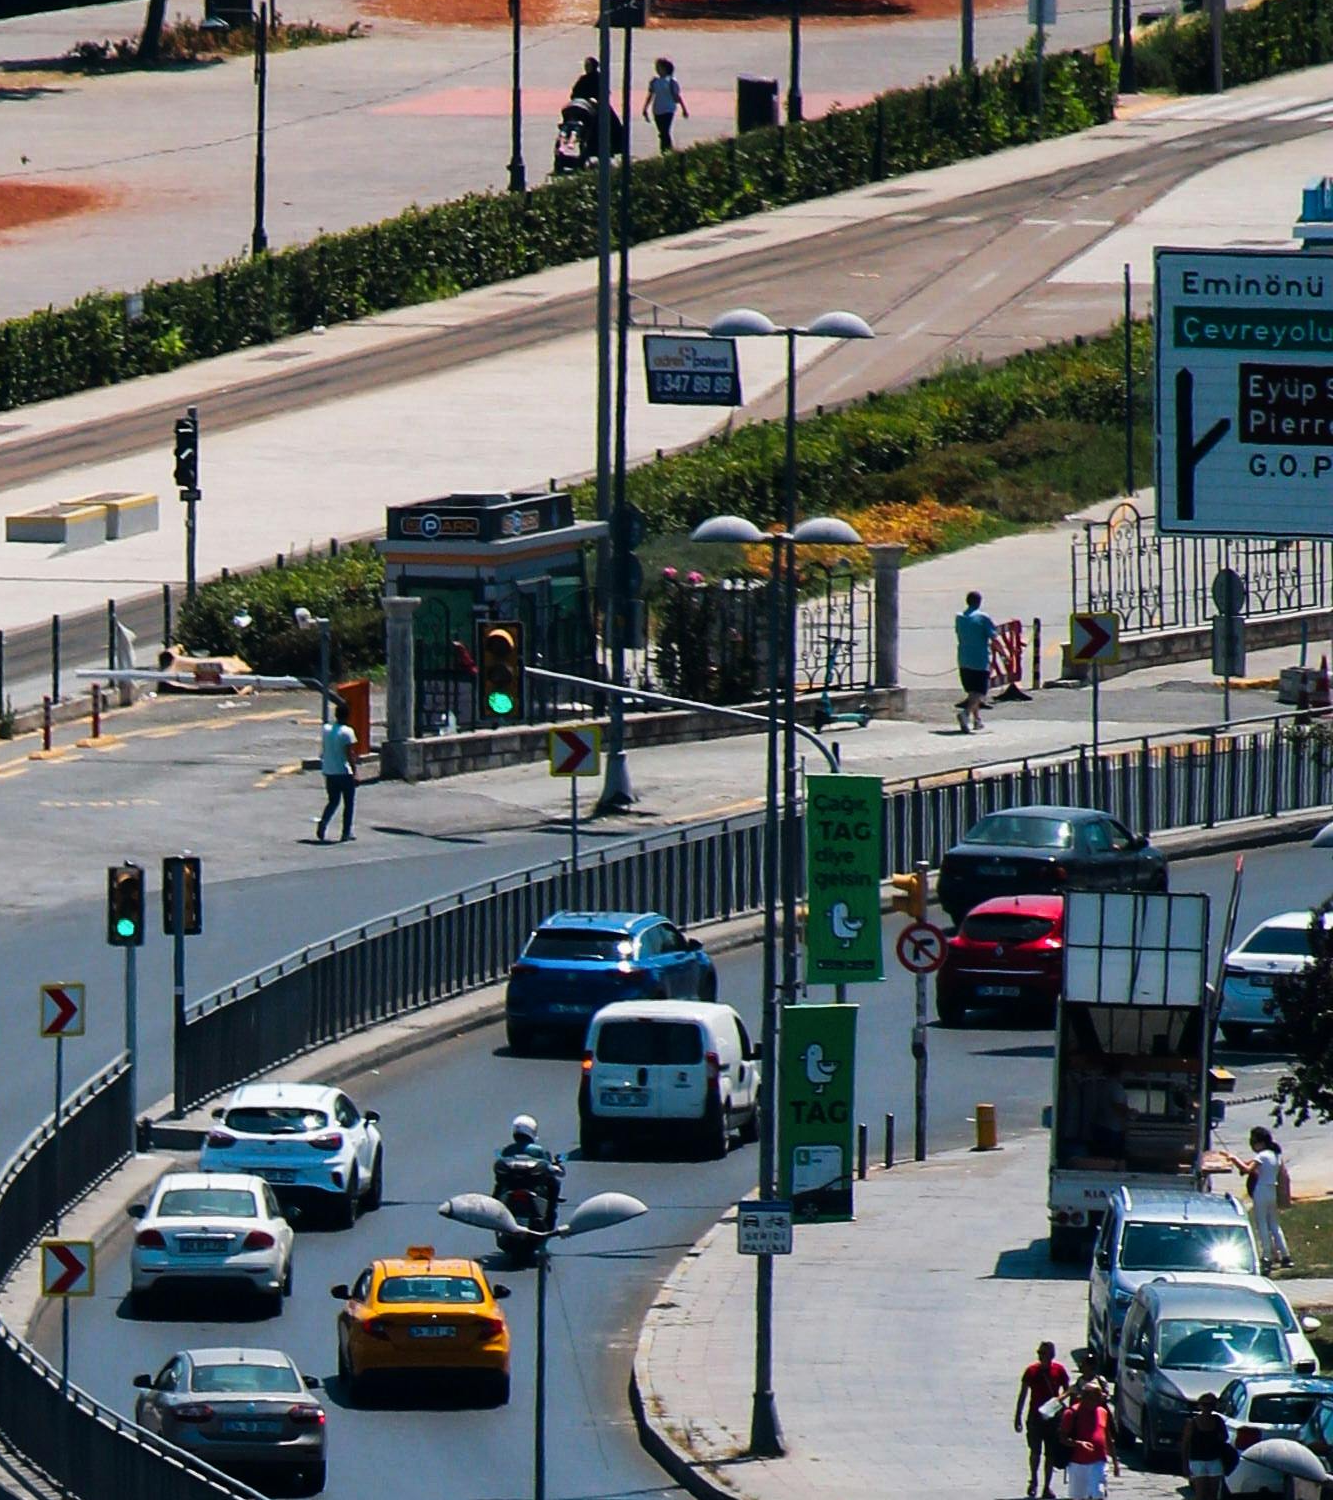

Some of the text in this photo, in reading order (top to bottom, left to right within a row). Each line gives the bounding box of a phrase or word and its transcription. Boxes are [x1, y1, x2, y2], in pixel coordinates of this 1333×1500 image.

[1183, 271, 1323, 297] Eminönü
[1183, 317, 1333, 347] Çevreyolu
[1249, 375, 1316, 406] Eyüp
[1250, 409, 1333, 435] Pierr
[819, 821, 871, 841] TAG
[790, 1100, 848, 1124] TAG
